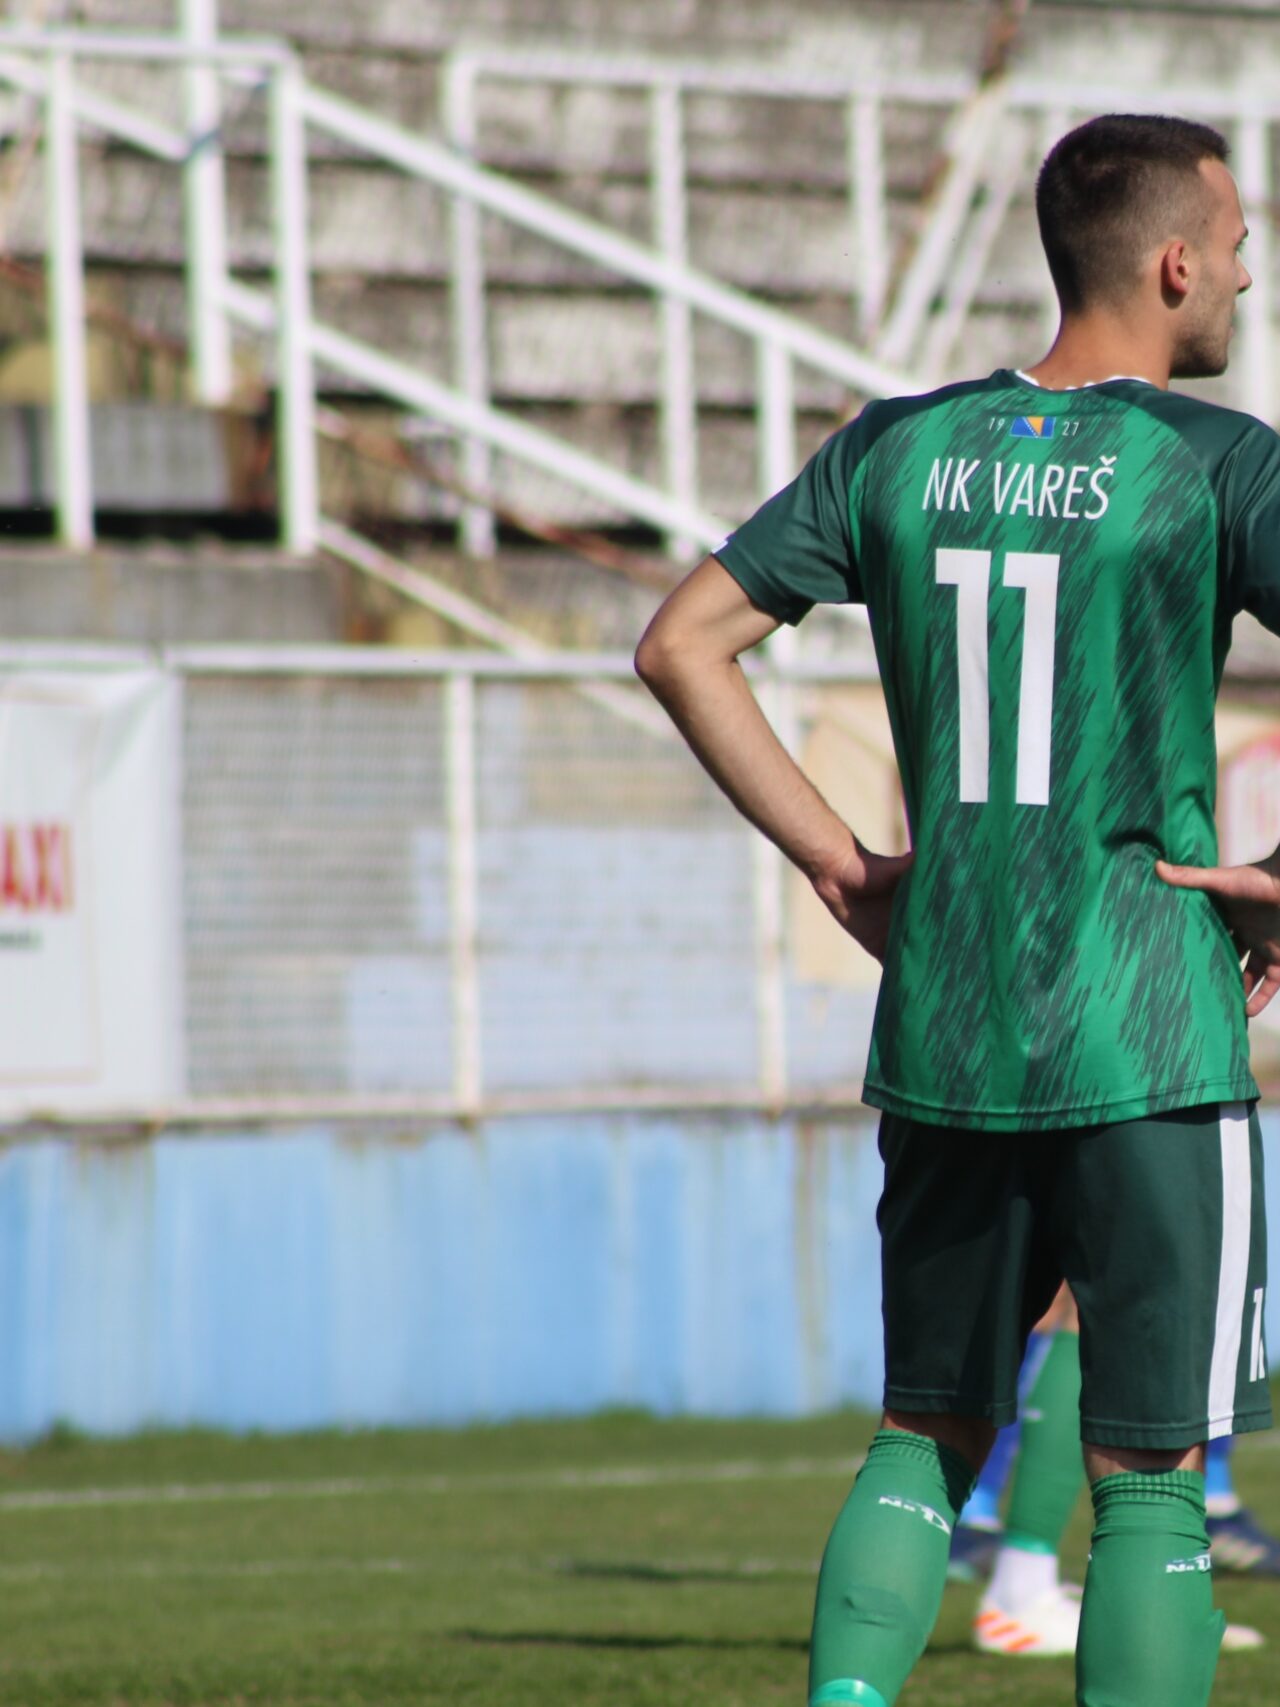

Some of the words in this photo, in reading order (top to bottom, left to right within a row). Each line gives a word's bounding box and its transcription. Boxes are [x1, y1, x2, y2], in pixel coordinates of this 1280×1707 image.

[988, 417, 1005, 432] 19
[1062, 421, 1080, 437] 27
[922, 457, 981, 513] NK
[994, 455, 1118, 520] VAREŠ
[935, 548, 1060, 806] 11
